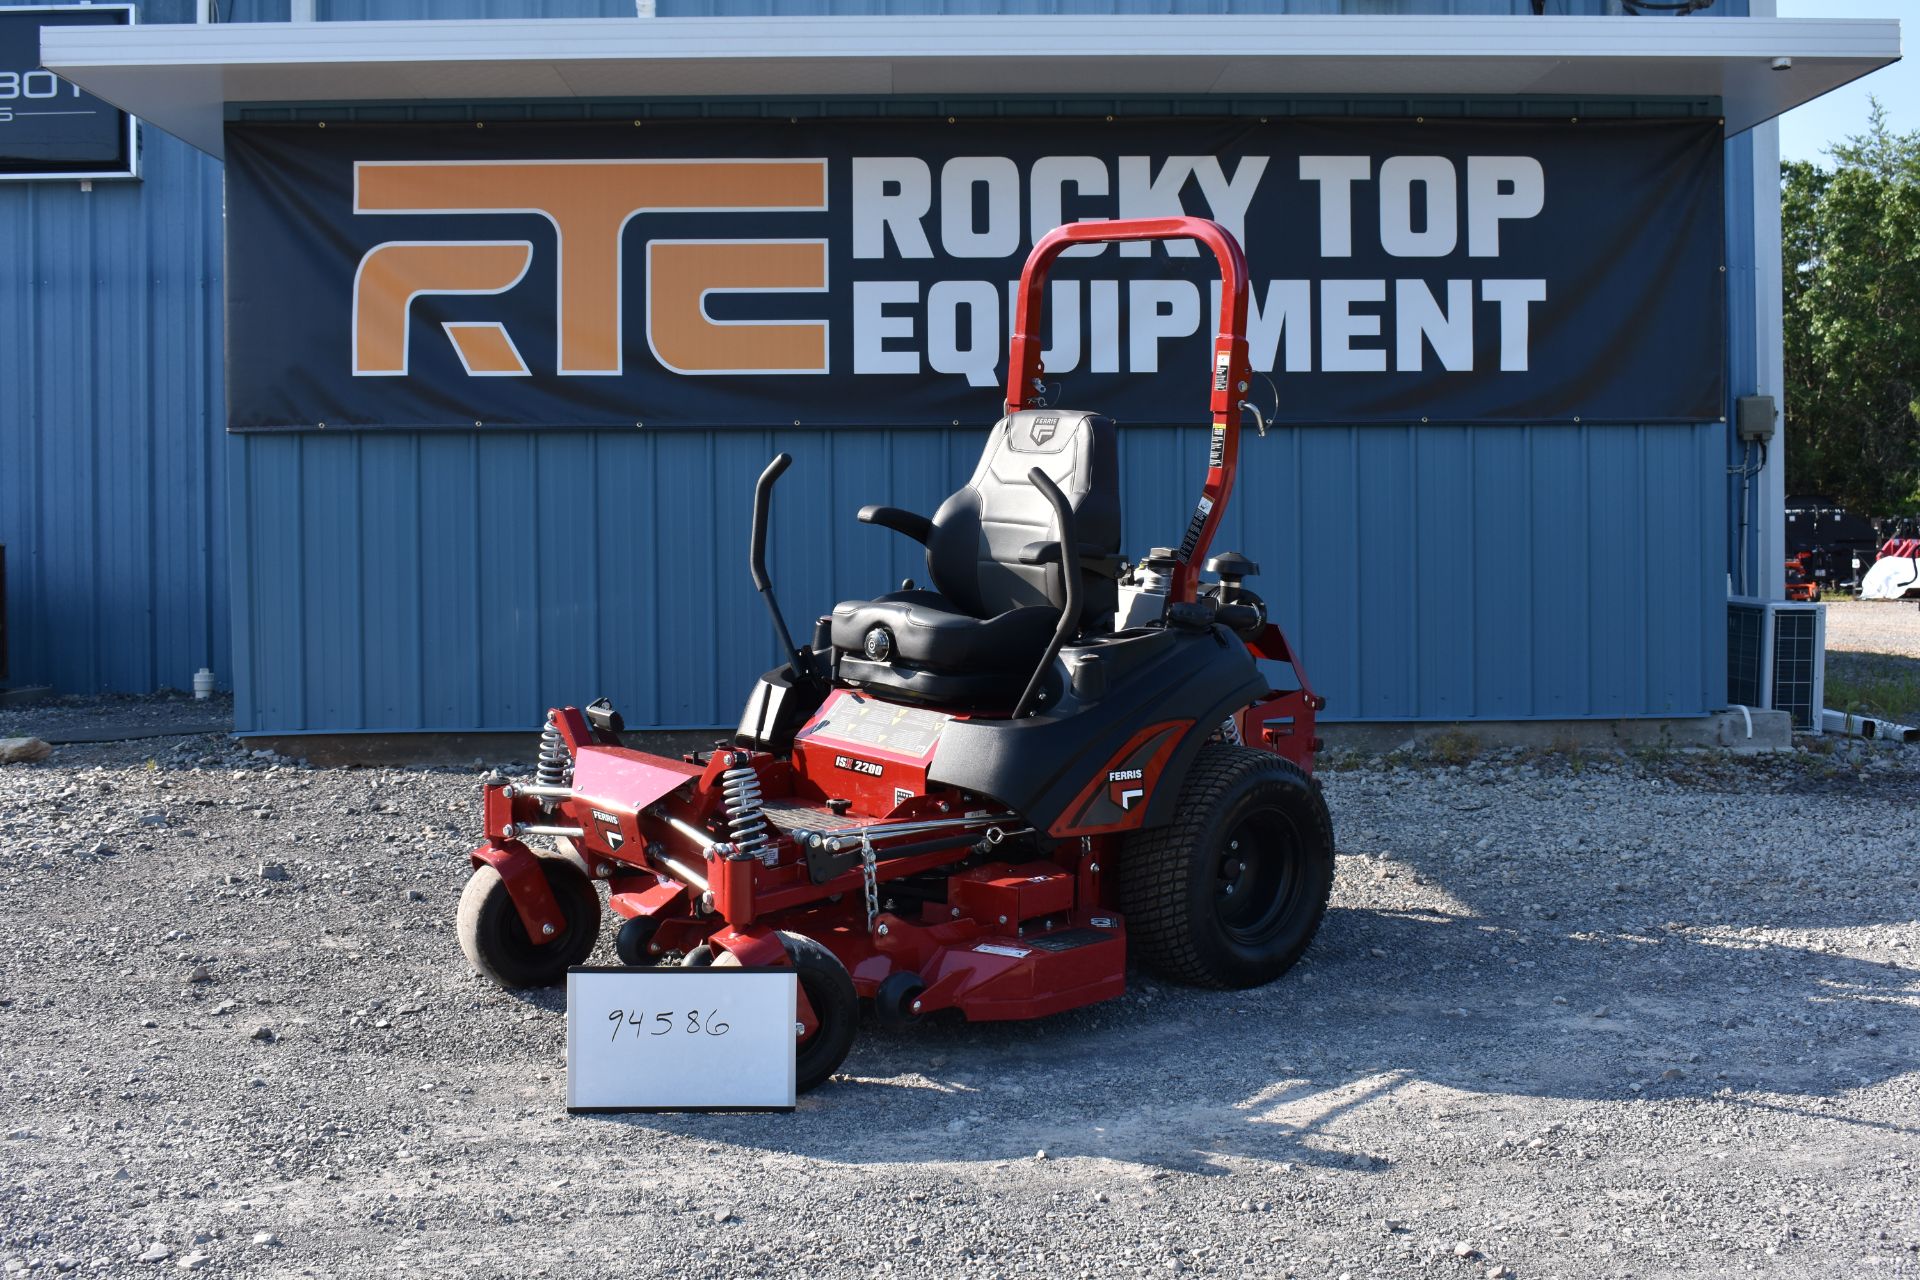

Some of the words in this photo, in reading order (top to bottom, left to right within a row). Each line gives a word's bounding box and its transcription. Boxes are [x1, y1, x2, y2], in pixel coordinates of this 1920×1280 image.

[852, 155, 1270, 258] ROCKY
[1299, 155, 1546, 258] TOP
[352, 157, 829, 376] RTE
[852, 279, 1547, 387] EQUIPMENT
[854, 760, 883, 776] 2200
[1109, 769, 1142, 781] FERRIS
[593, 810, 620, 825] FERRIS
[608, 1008, 730, 1042] 94586
